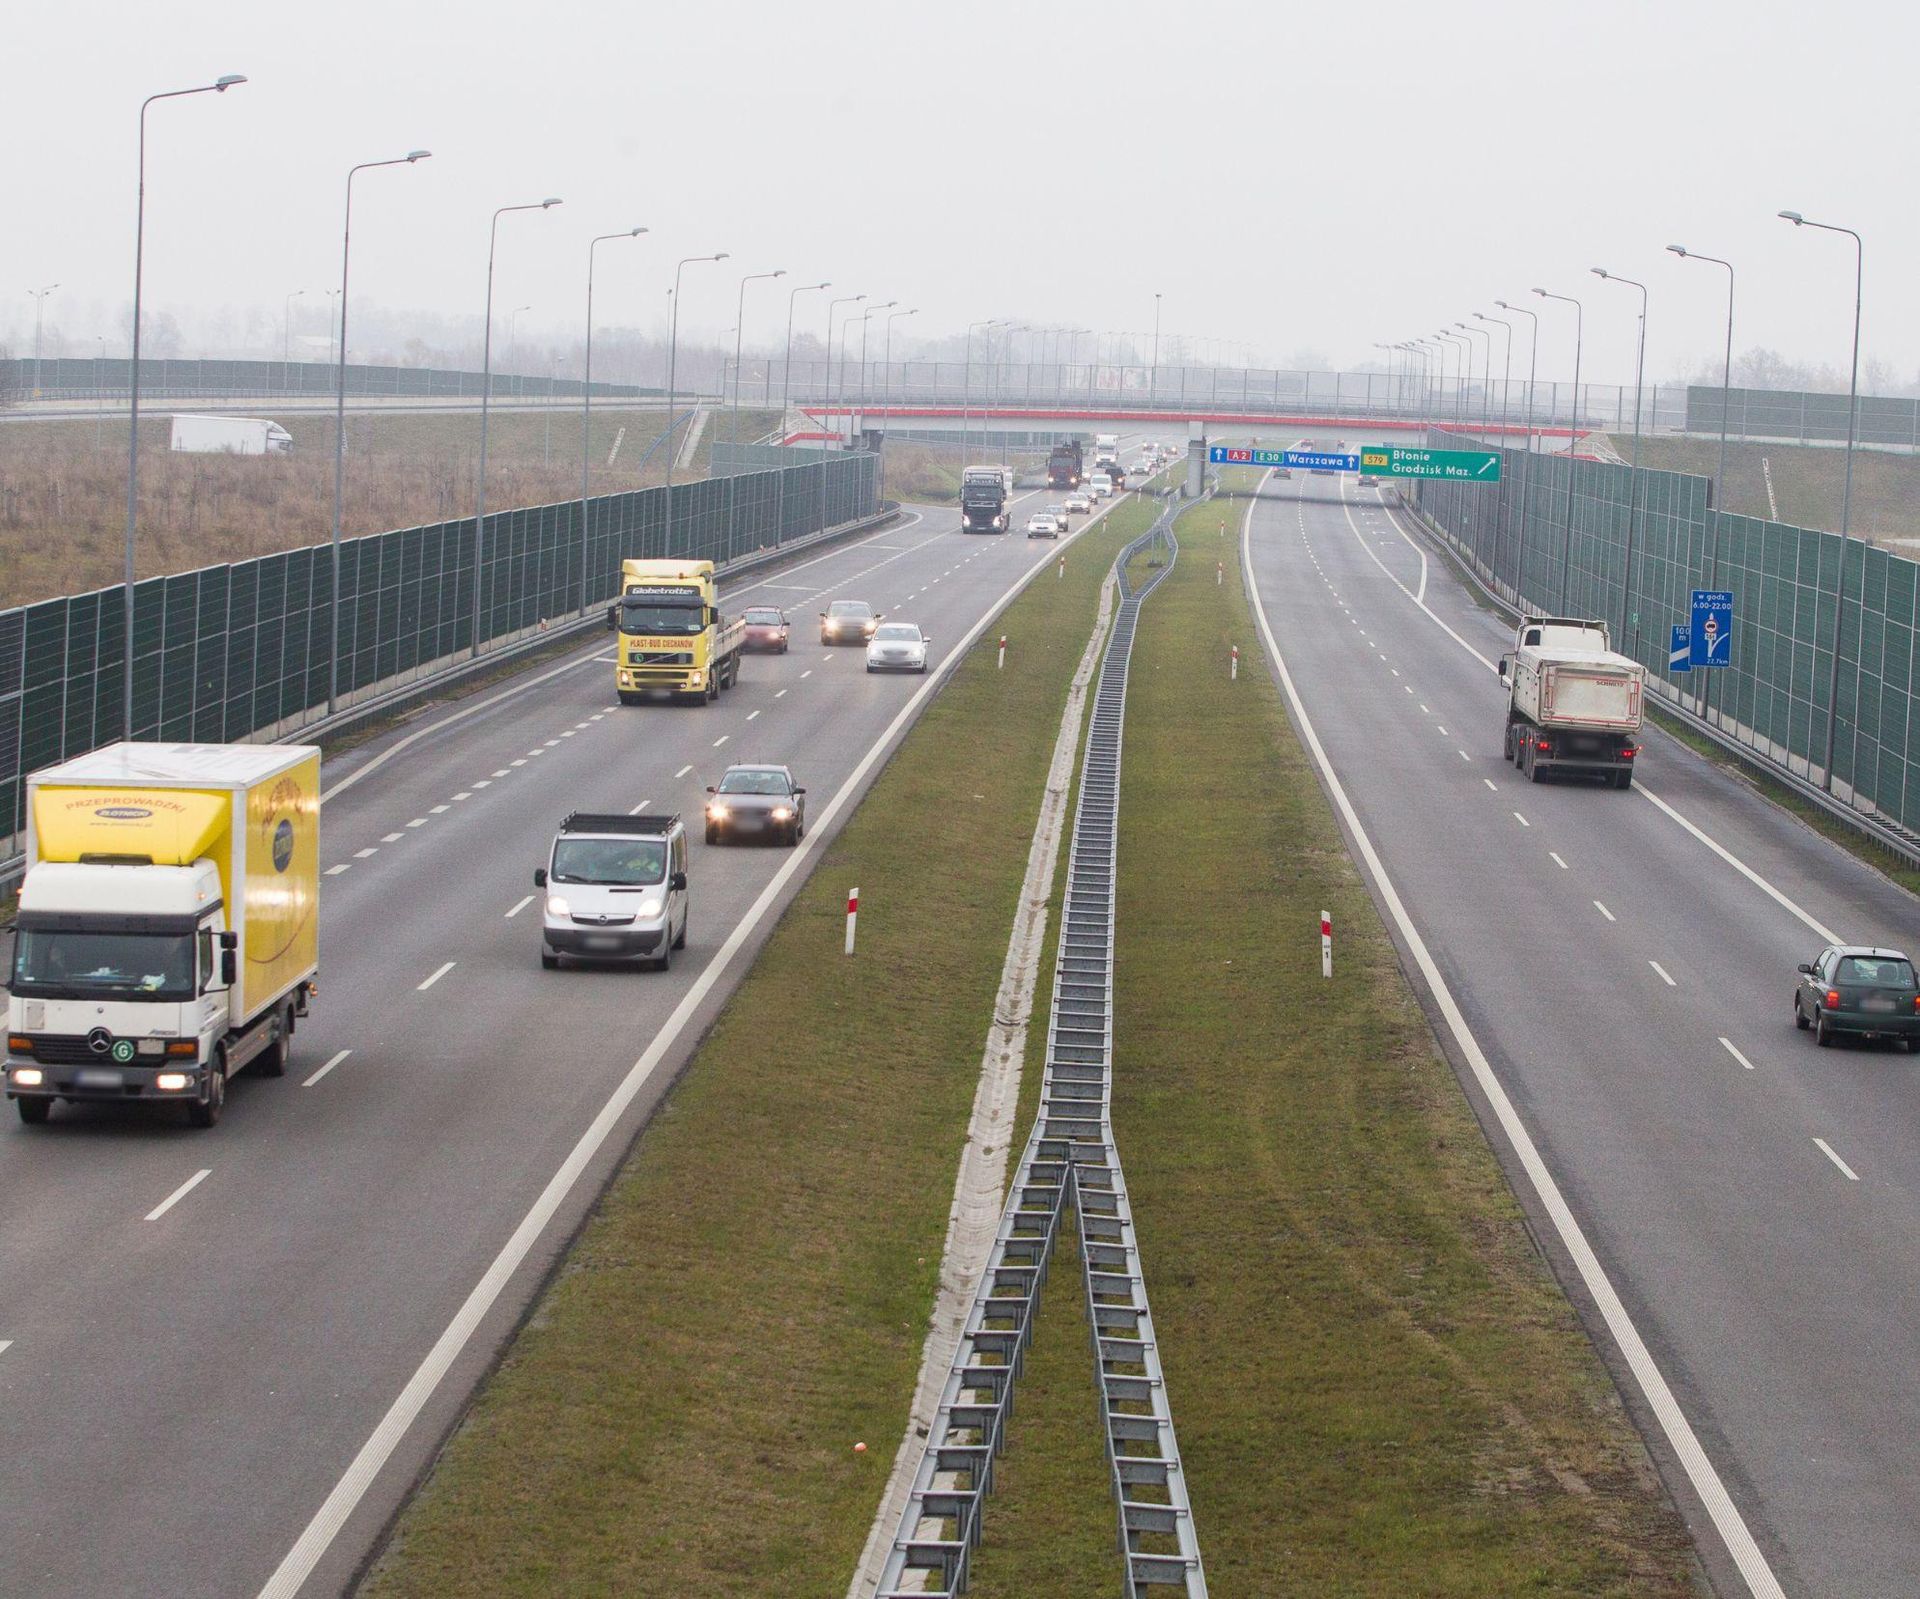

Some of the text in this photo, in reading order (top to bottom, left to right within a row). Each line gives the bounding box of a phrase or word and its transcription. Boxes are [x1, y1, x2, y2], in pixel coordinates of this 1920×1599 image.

[1288, 453, 1343, 466] Warszawa
[1393, 450, 1430, 461] Błonie
[1392, 463, 1472, 476] Grodzisk Maz.
[632, 587, 695, 595] Globetrotter
[65, 797, 186, 813] PRZEPROWADZKI
[118, 1045, 128, 1057] G
